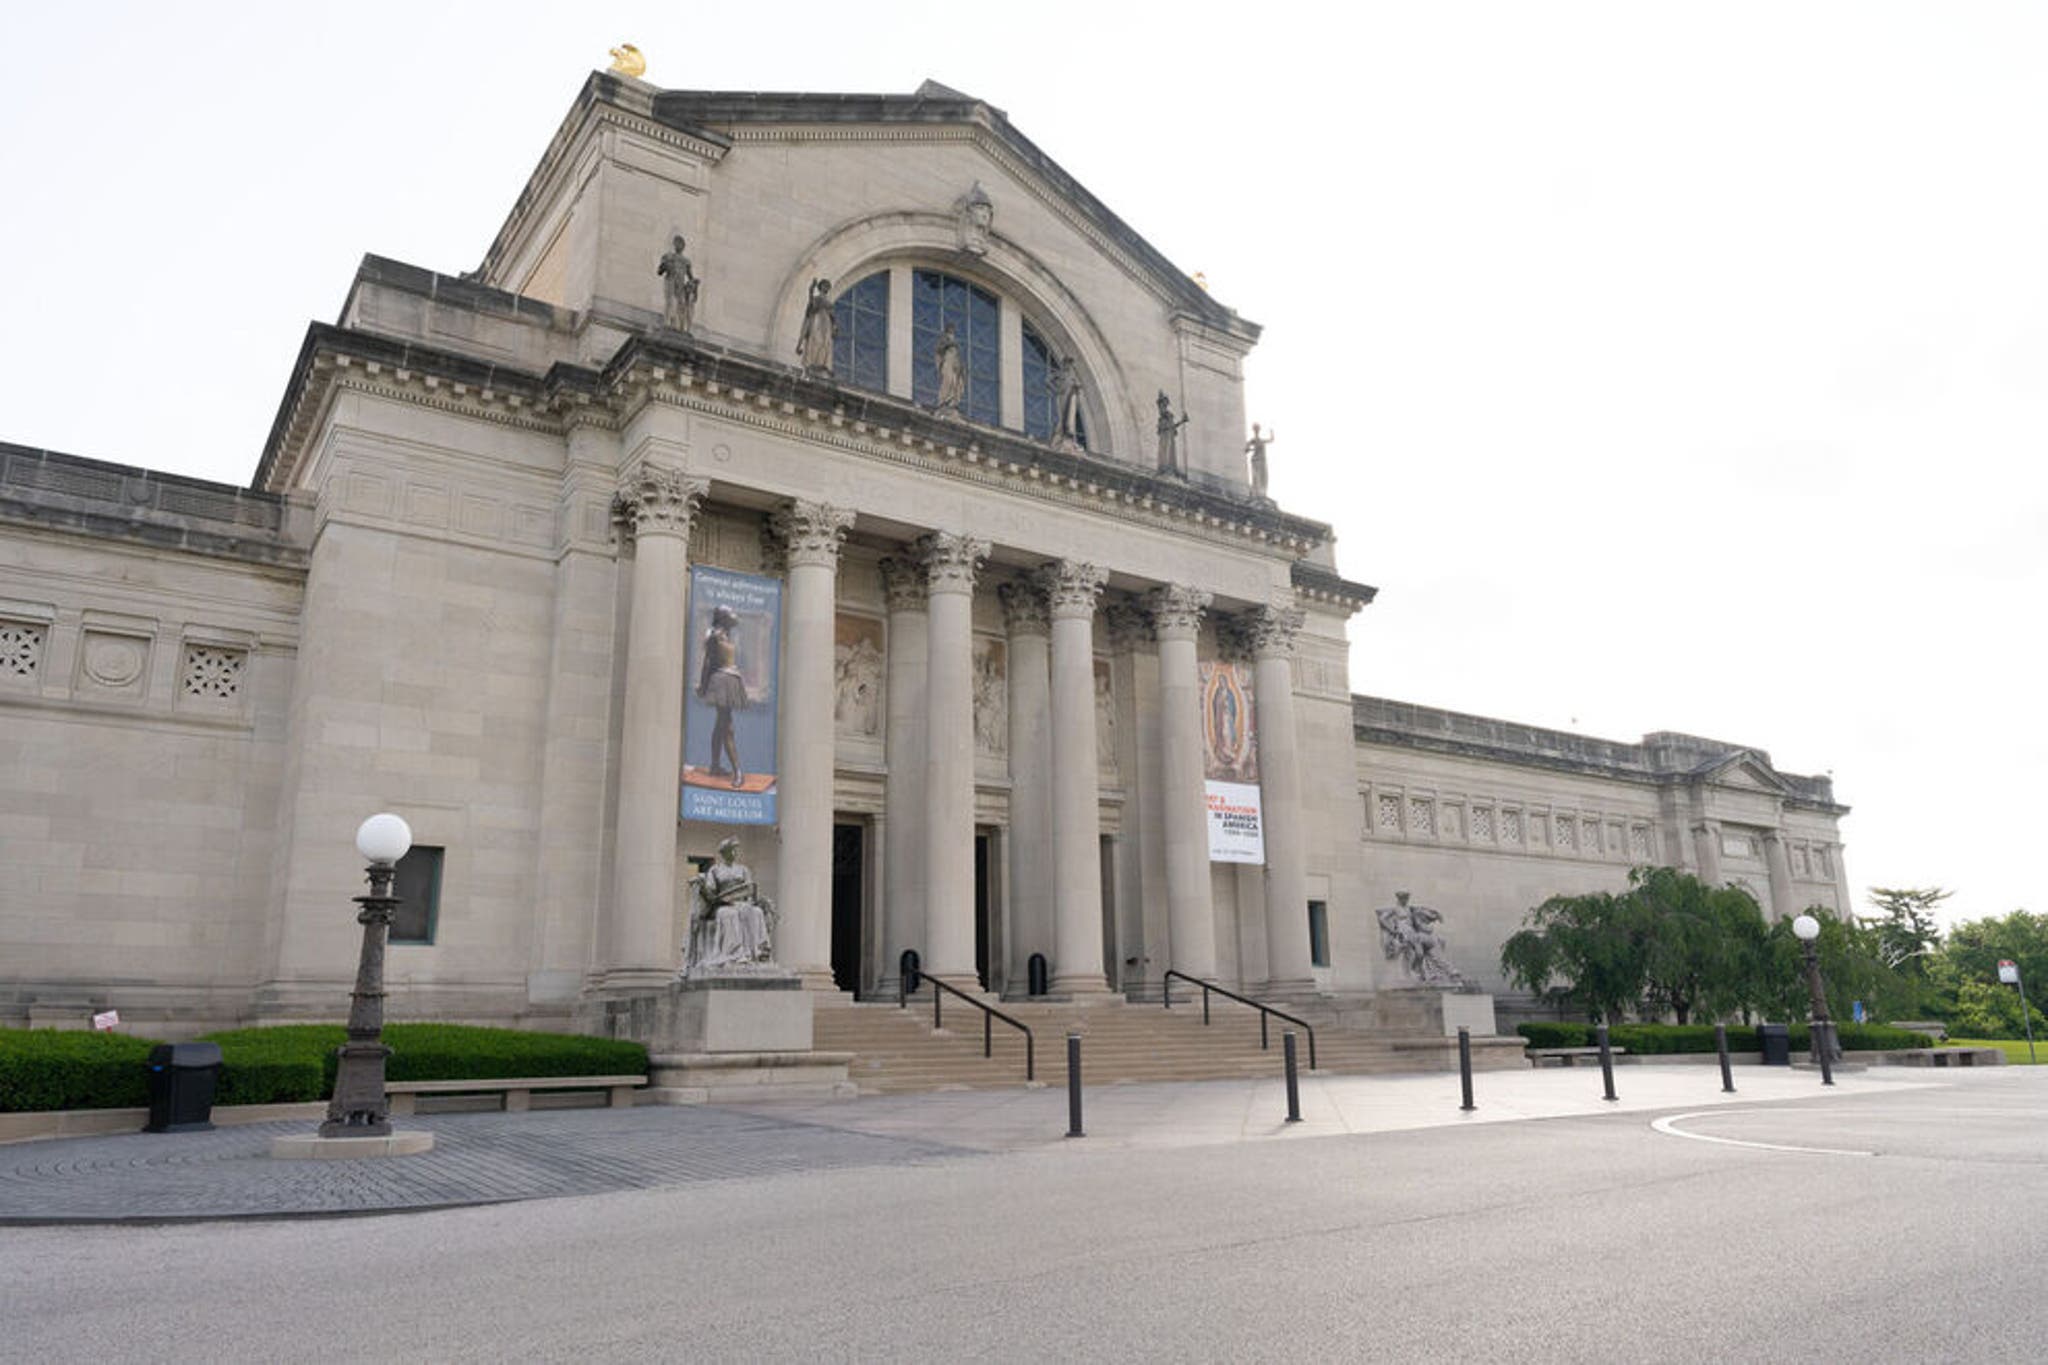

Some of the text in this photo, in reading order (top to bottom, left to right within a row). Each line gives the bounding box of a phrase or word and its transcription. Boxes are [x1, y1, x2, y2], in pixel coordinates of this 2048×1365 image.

[692, 793, 763, 808] SAINT LOUIS
[692, 805, 763, 819] ART MUSEUM
[1224, 812, 1258, 822] SPANISH
[1222, 821, 1258, 830] AMERICA
